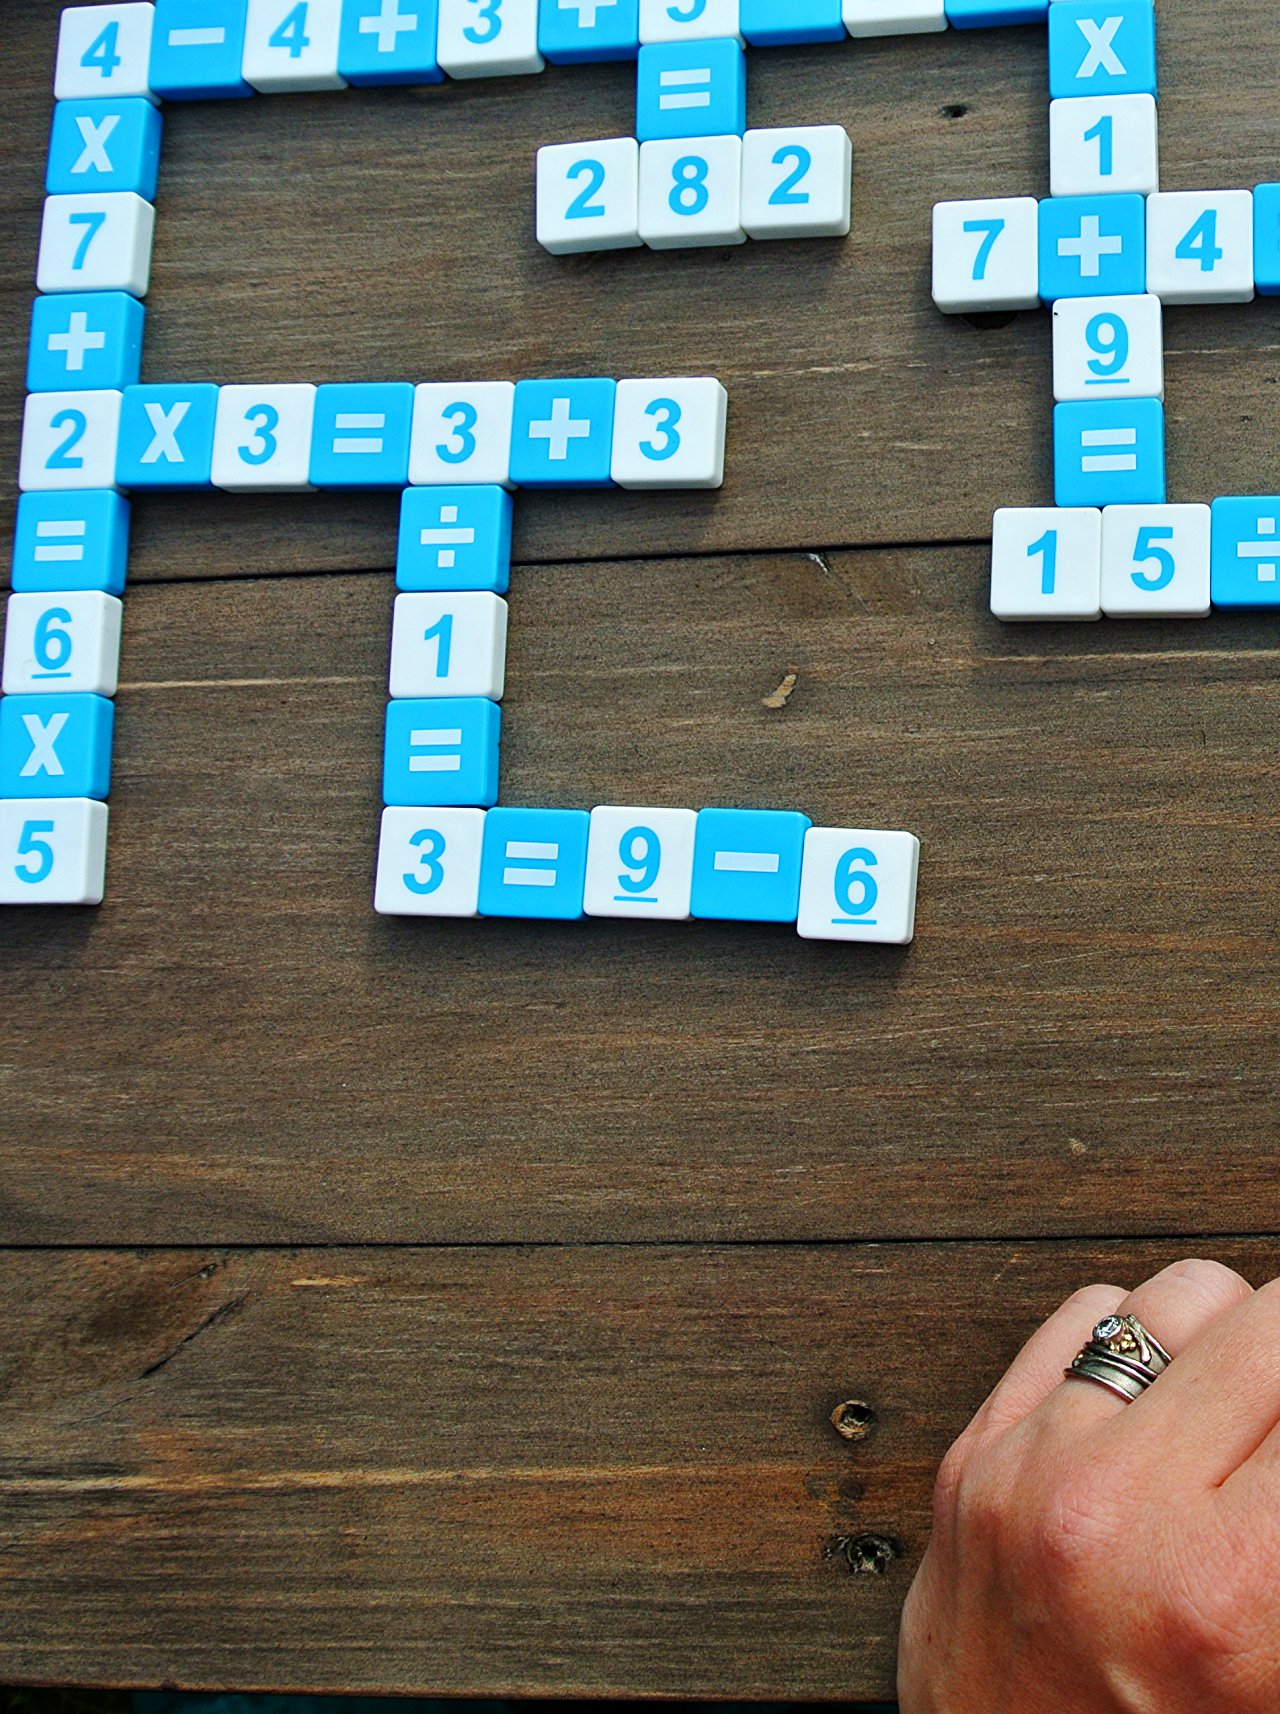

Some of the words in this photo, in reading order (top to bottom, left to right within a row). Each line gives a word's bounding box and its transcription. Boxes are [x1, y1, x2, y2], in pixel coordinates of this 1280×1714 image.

[79, 20, 122, 79] 4
[267, 0, 311, 59] 4
[1083, 115, 1113, 176] 1
[564, 159, 606, 220] 2
[667, 155, 709, 217] 8
[768, 144, 812, 205] 2
[68, 211, 107, 271] 7
[962, 218, 1006, 281] 7
[1174, 209, 1224, 272] 4
[1083, 312, 1131, 385] 9
[43, 408, 89, 470] 2
[237, 403, 280, 467] 3
[435, 401, 478, 465] 3
[638, 397, 682, 462] 3
[1026, 529, 1058, 595] 1
[1130, 526, 1176, 592] 5
[31, 607, 73, 680] 6
[424, 613, 454, 678] 1
[13, 819, 56, 884] 5
[402, 828, 447, 895] 3
[613, 825, 662, 903] 9
[831, 847, 878, 925] 6
